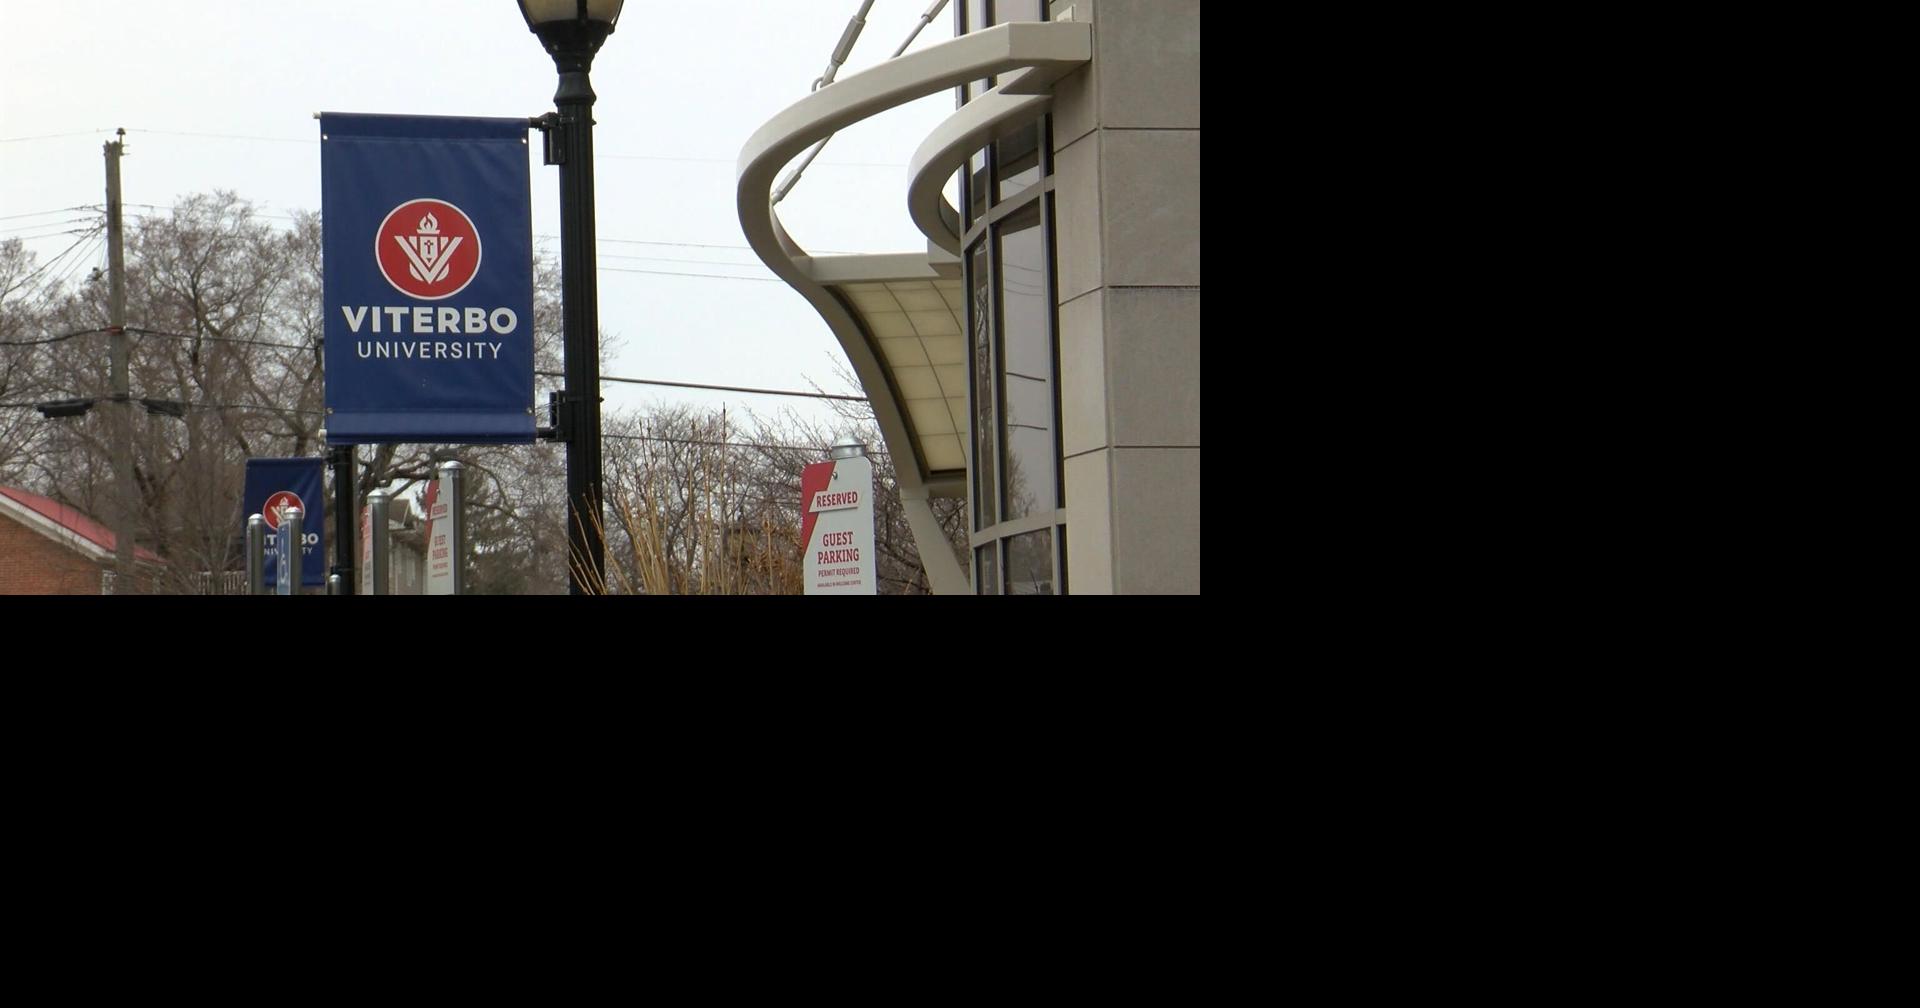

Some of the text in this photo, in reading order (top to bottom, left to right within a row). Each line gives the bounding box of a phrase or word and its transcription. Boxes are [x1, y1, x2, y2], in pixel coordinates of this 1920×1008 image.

[341, 306, 518, 335] VITERBO
[357, 341, 503, 360] UNIVERSITY
[816, 491, 859, 508] RESERVED
[263, 533, 320, 545] ITBO
[822, 531, 854, 547] GUEST
[817, 548, 860, 565] PARKING
[818, 567, 860, 578] PERMIT REQUIRED
